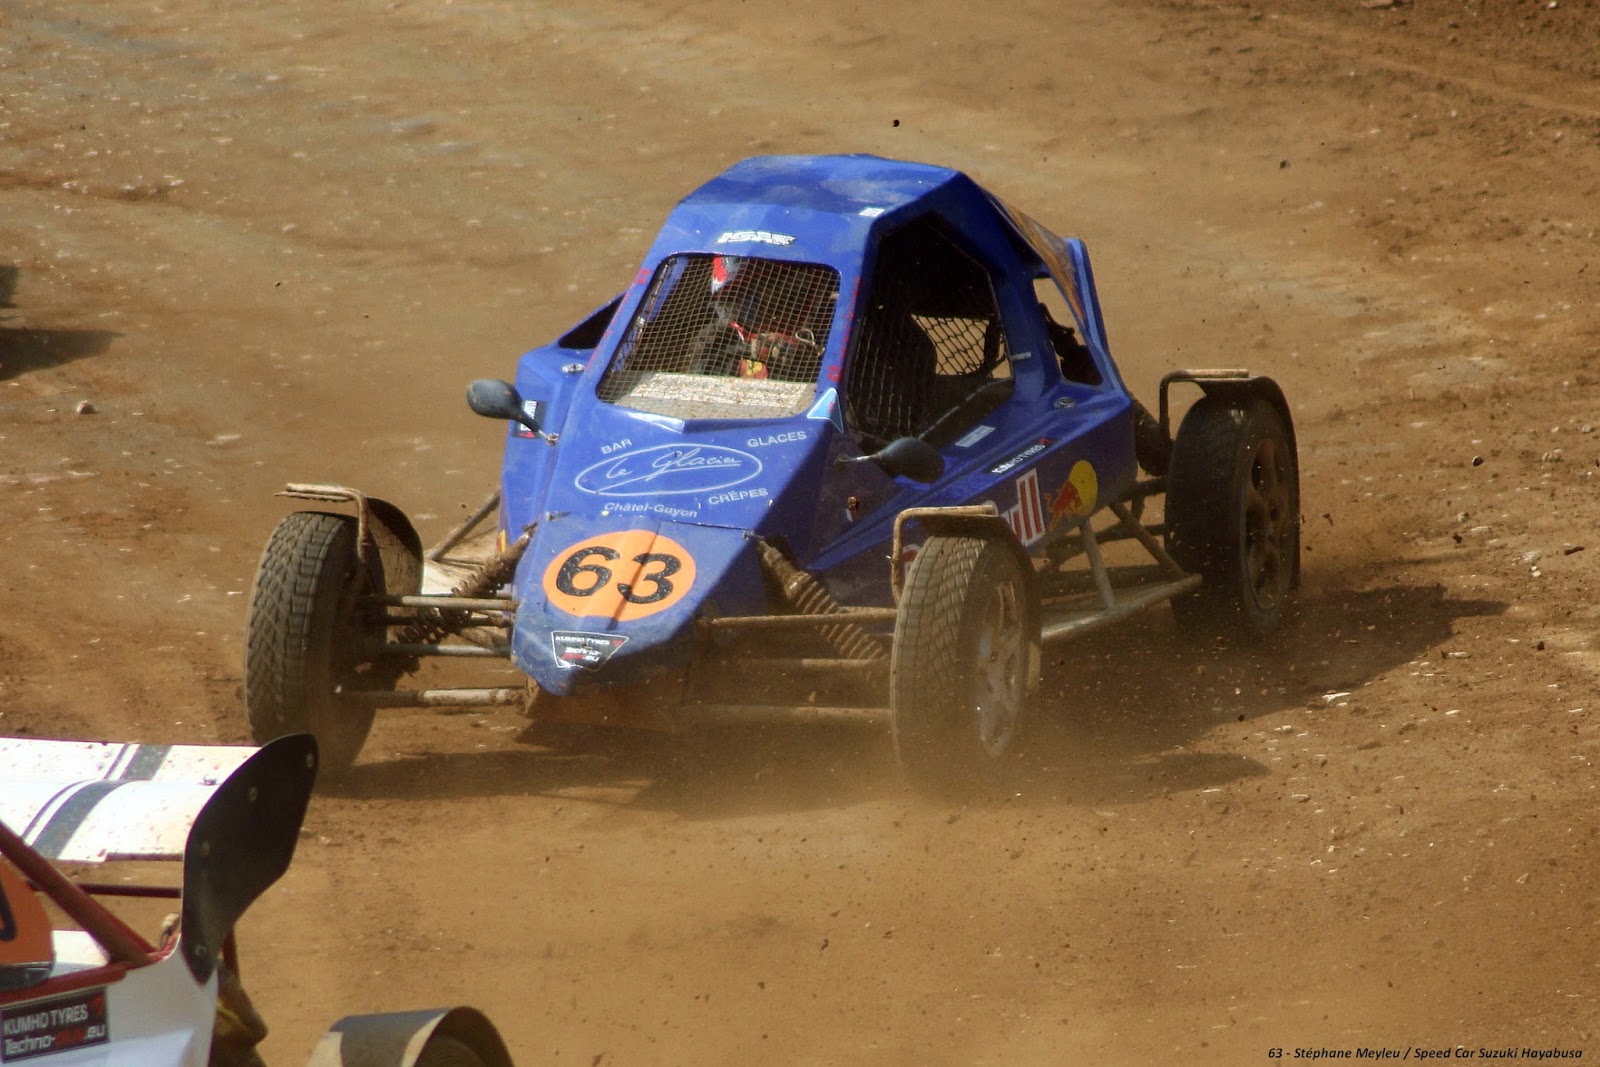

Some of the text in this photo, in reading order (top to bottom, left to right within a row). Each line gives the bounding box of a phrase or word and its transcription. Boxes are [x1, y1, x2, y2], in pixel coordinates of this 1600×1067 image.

[601, 438, 633, 455] BAR
[747, 431, 808, 448] GLACES
[604, 502, 698, 518] Châtel-Guyon
[556, 546, 682, 605] 63
[4, 1004, 89, 1035] KUMHO TYRES
